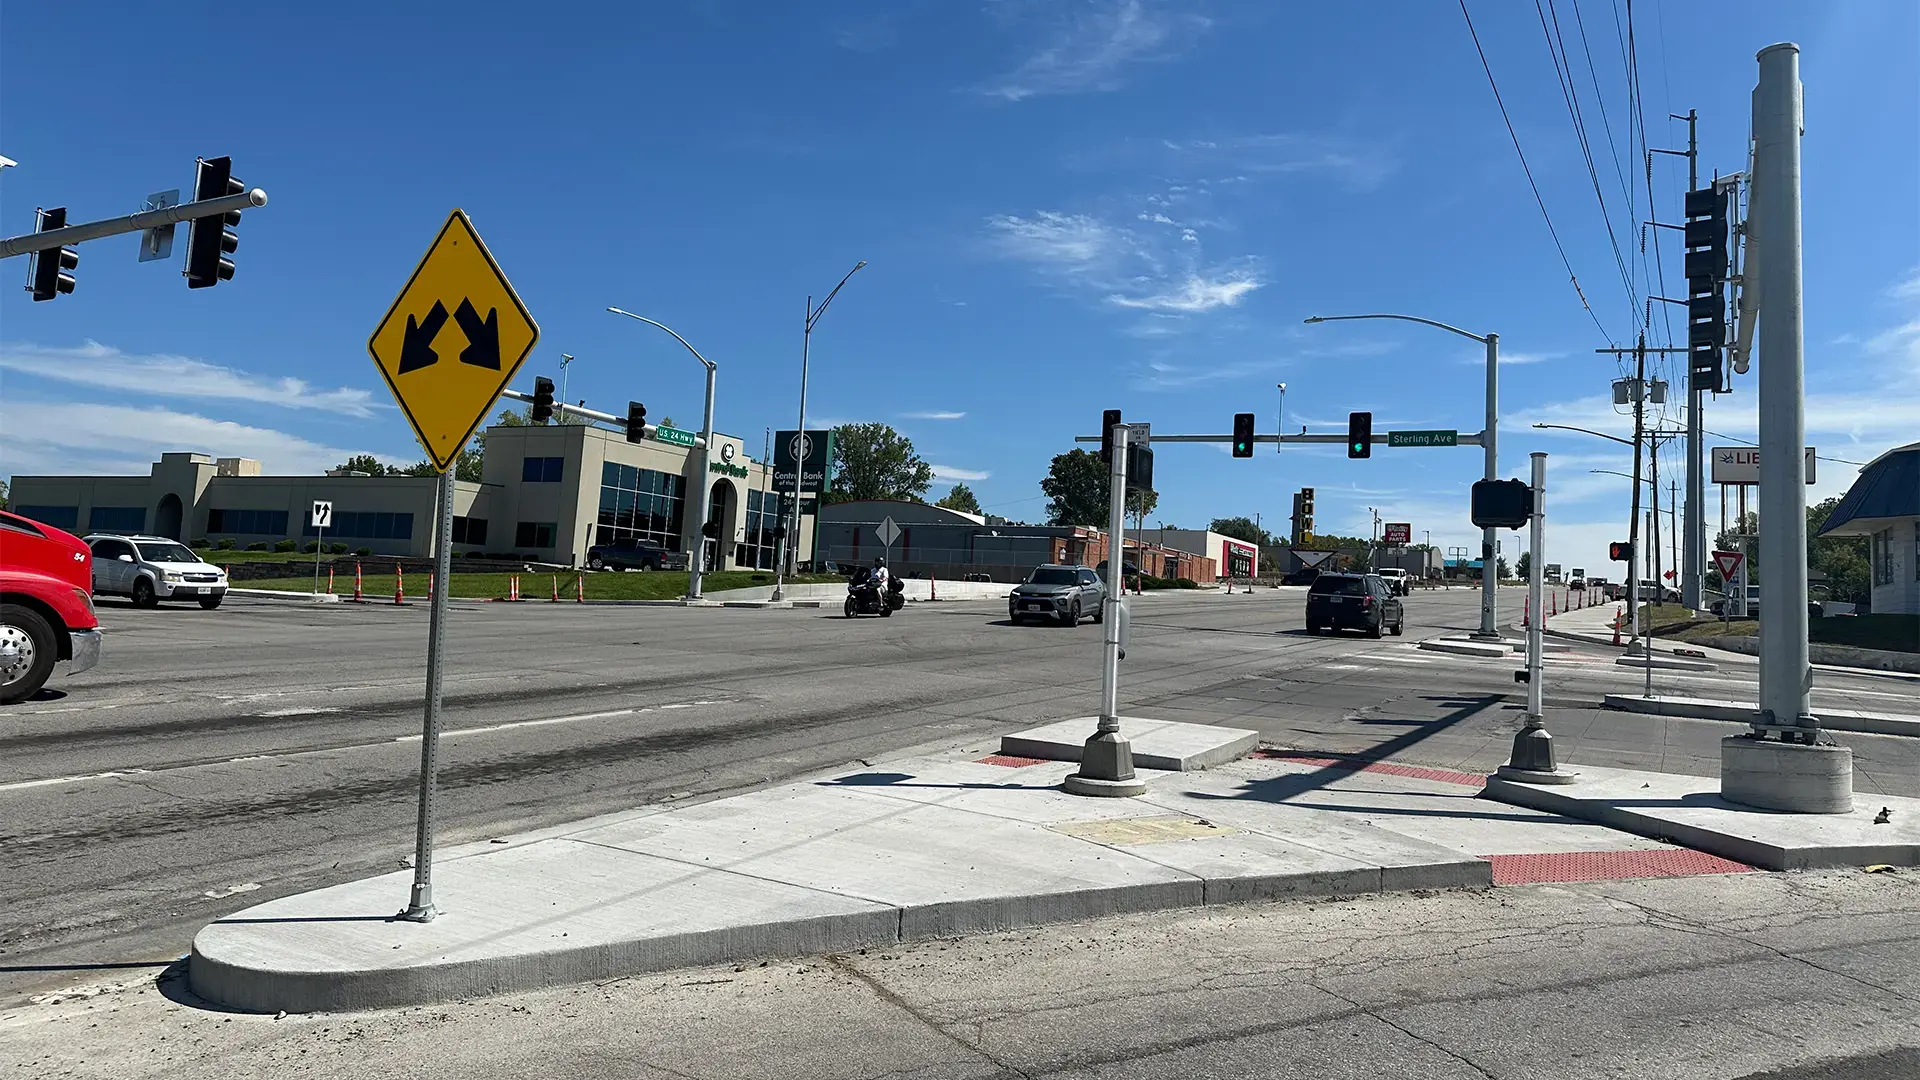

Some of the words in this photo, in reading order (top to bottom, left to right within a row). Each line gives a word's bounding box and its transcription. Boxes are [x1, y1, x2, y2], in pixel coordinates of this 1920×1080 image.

[671, 431, 679, 440] 24
[681, 433, 693, 444] Hwy
[1393, 434, 1430, 445] Sterling
[1433, 434, 1452, 443] Ave
[803, 471, 823, 480] Bank
[1300, 488, 1314, 544] BOWL
